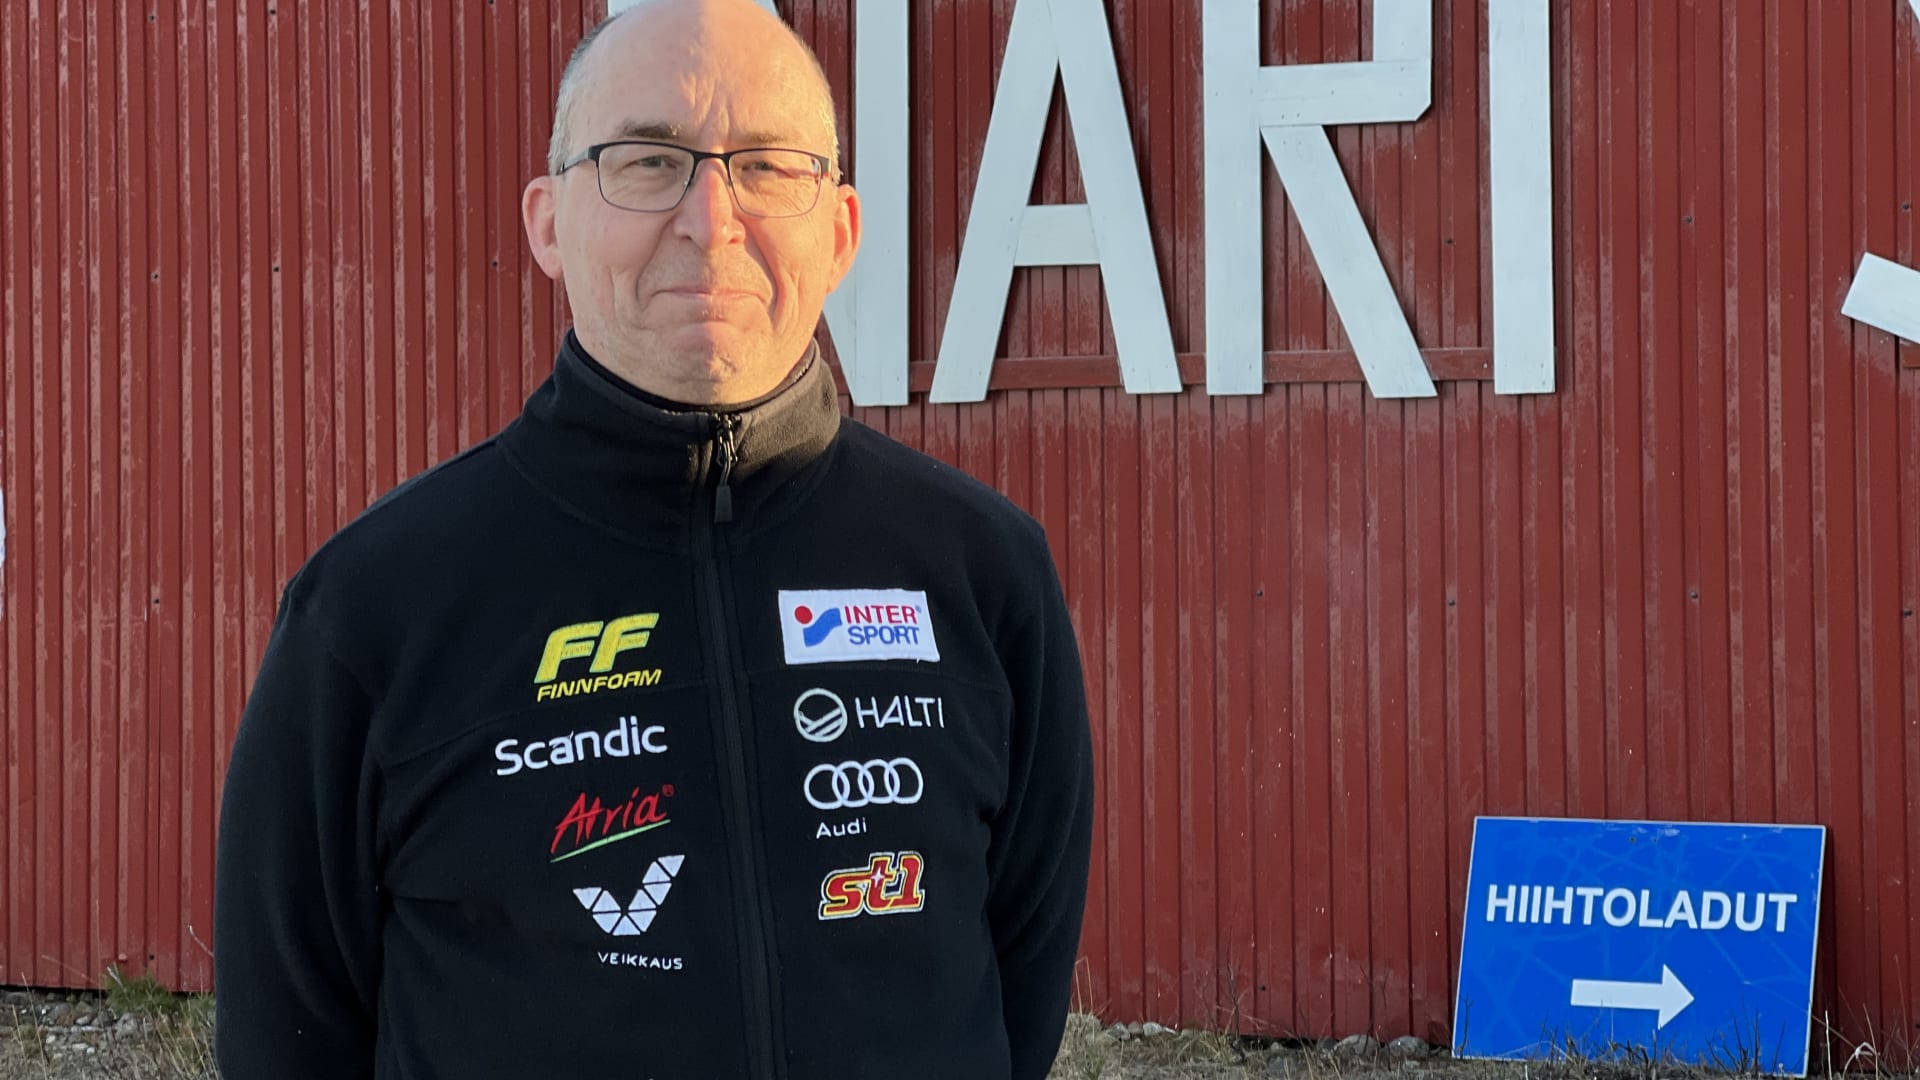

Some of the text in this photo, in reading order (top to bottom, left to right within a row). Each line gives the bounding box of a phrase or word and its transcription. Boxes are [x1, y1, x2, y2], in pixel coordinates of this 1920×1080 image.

[608, 0, 1554, 406] ARI
[844, 605, 917, 624] INTER
[534, 613, 660, 683] FF
[848, 625, 920, 645] SPORT
[536, 668, 662, 702] FINNFOAM
[855, 695, 945, 728] HALTI
[495, 715, 668, 775] Scandic
[816, 817, 867, 839] Audi
[1486, 884, 1798, 932] HIIHTOLADUT
[597, 951, 683, 970] VEIKKAUS
